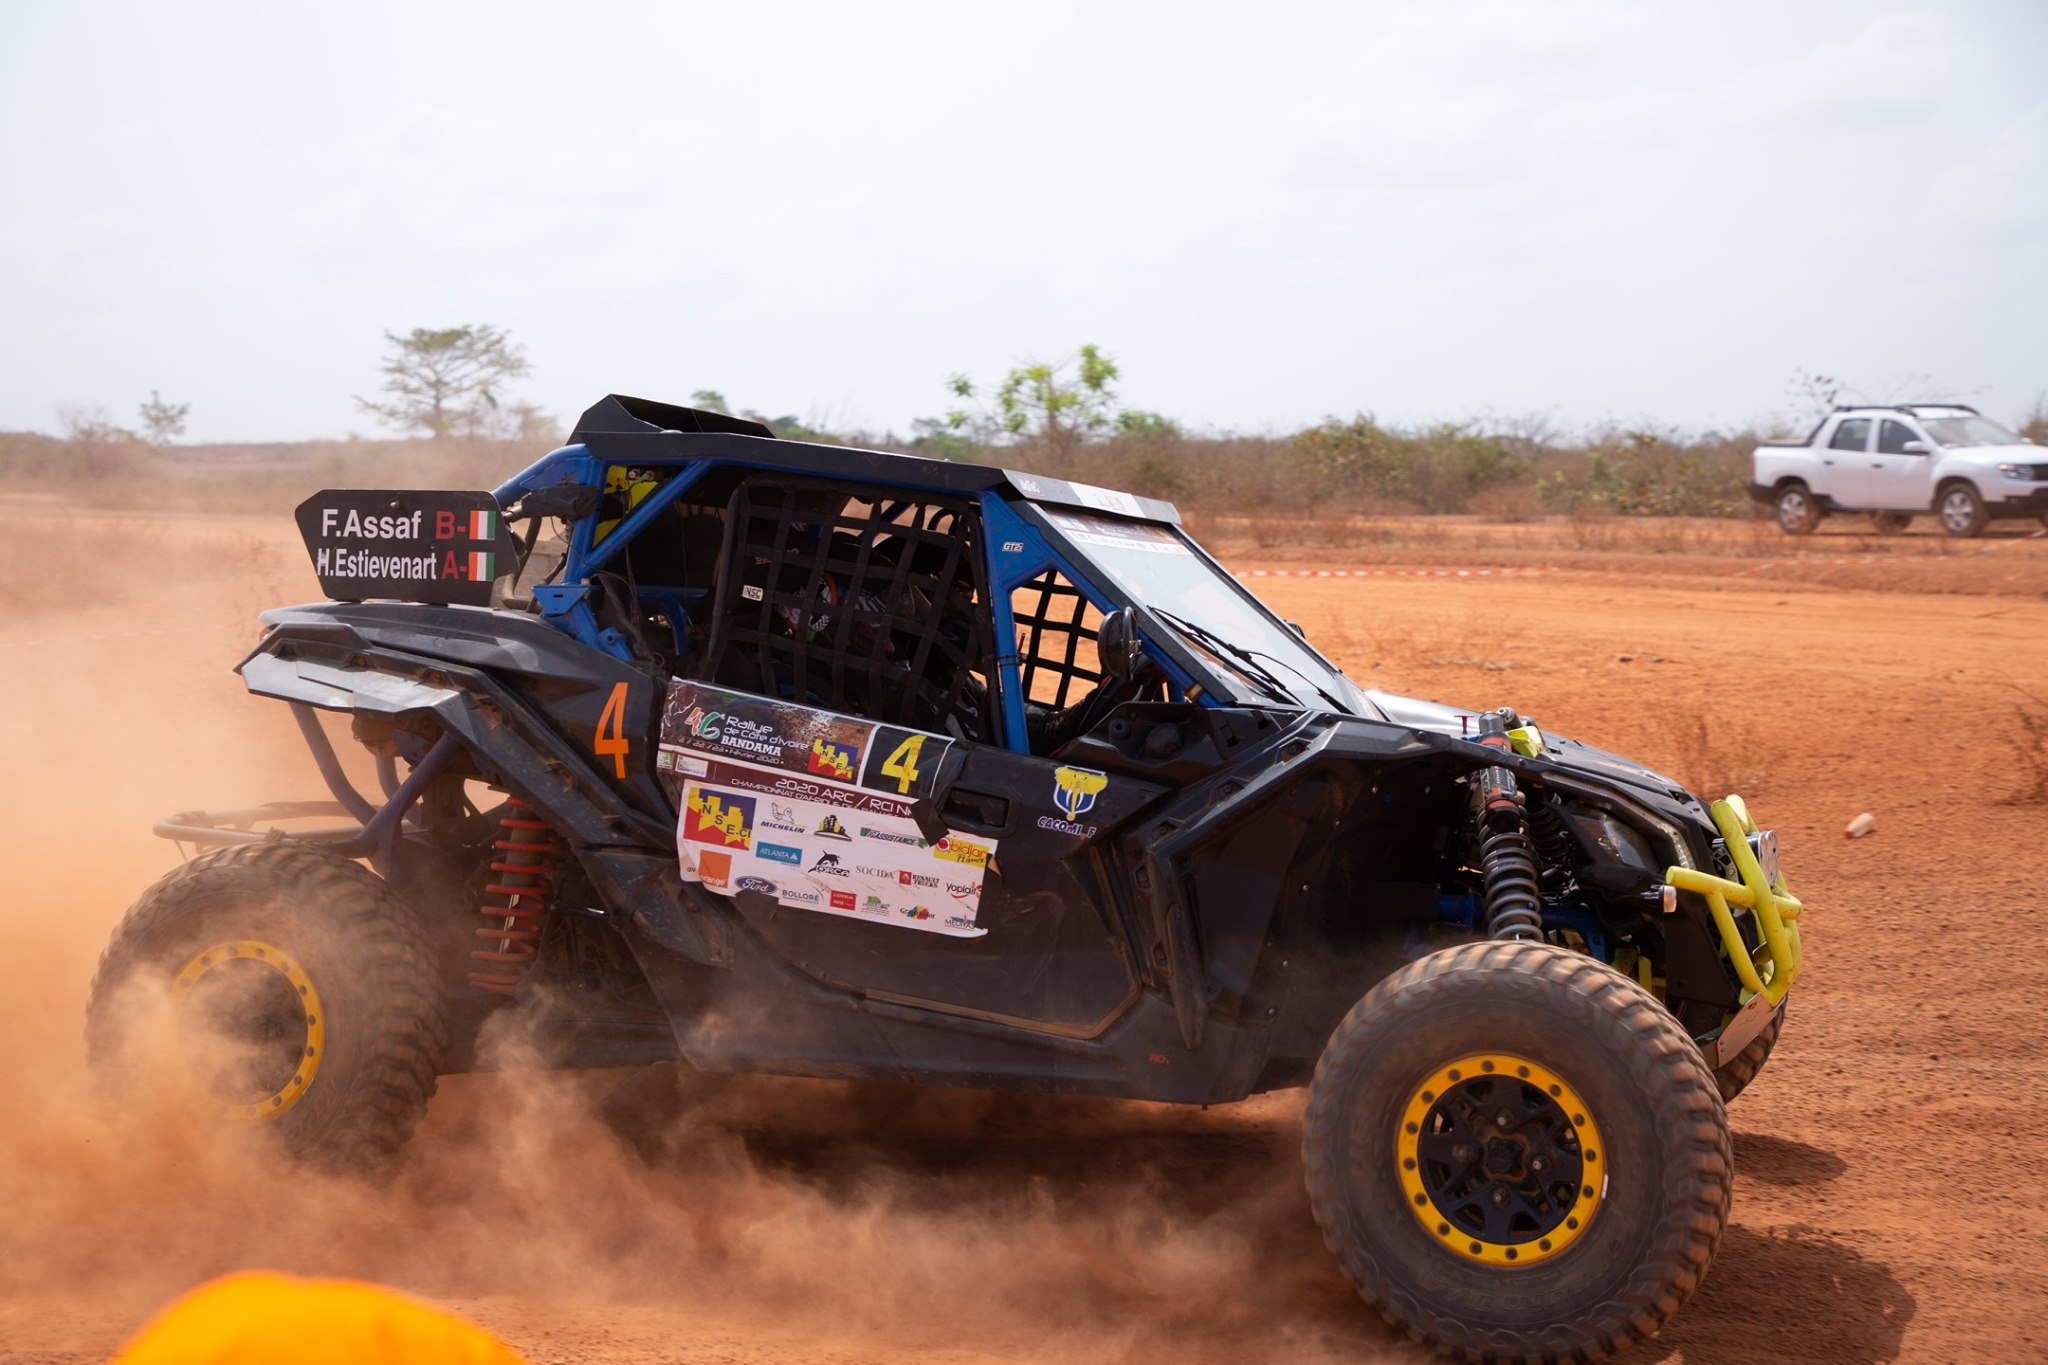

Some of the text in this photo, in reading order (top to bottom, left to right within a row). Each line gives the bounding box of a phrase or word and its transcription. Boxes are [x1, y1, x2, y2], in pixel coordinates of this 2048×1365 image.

[321, 508, 422, 539] F.Assaf
[316, 548, 437, 580] H.Estievenart
[594, 682, 630, 779] 4
[724, 726, 739, 736] de
[740, 727, 768, 742] Côte
[725, 715, 773, 735] Rallye
[720, 735, 782, 757] BANDAMA
[880, 734, 928, 794] 4
[731, 778, 793, 798] CHAMPIONNAT
[776, 778, 819, 795] 2020
[821, 789, 855, 804] ARC
[869, 798, 894, 812] RCI
[760, 820, 806, 834] MICHELIN
[759, 847, 790, 859] ATLANTA
[815, 864, 851, 877] ORCA
[855, 865, 895, 880] SOCIDA
[912, 874, 940, 884] RENAULT
[741, 877, 769, 892] Ford
[782, 888, 820, 901] BOLLORÉ
